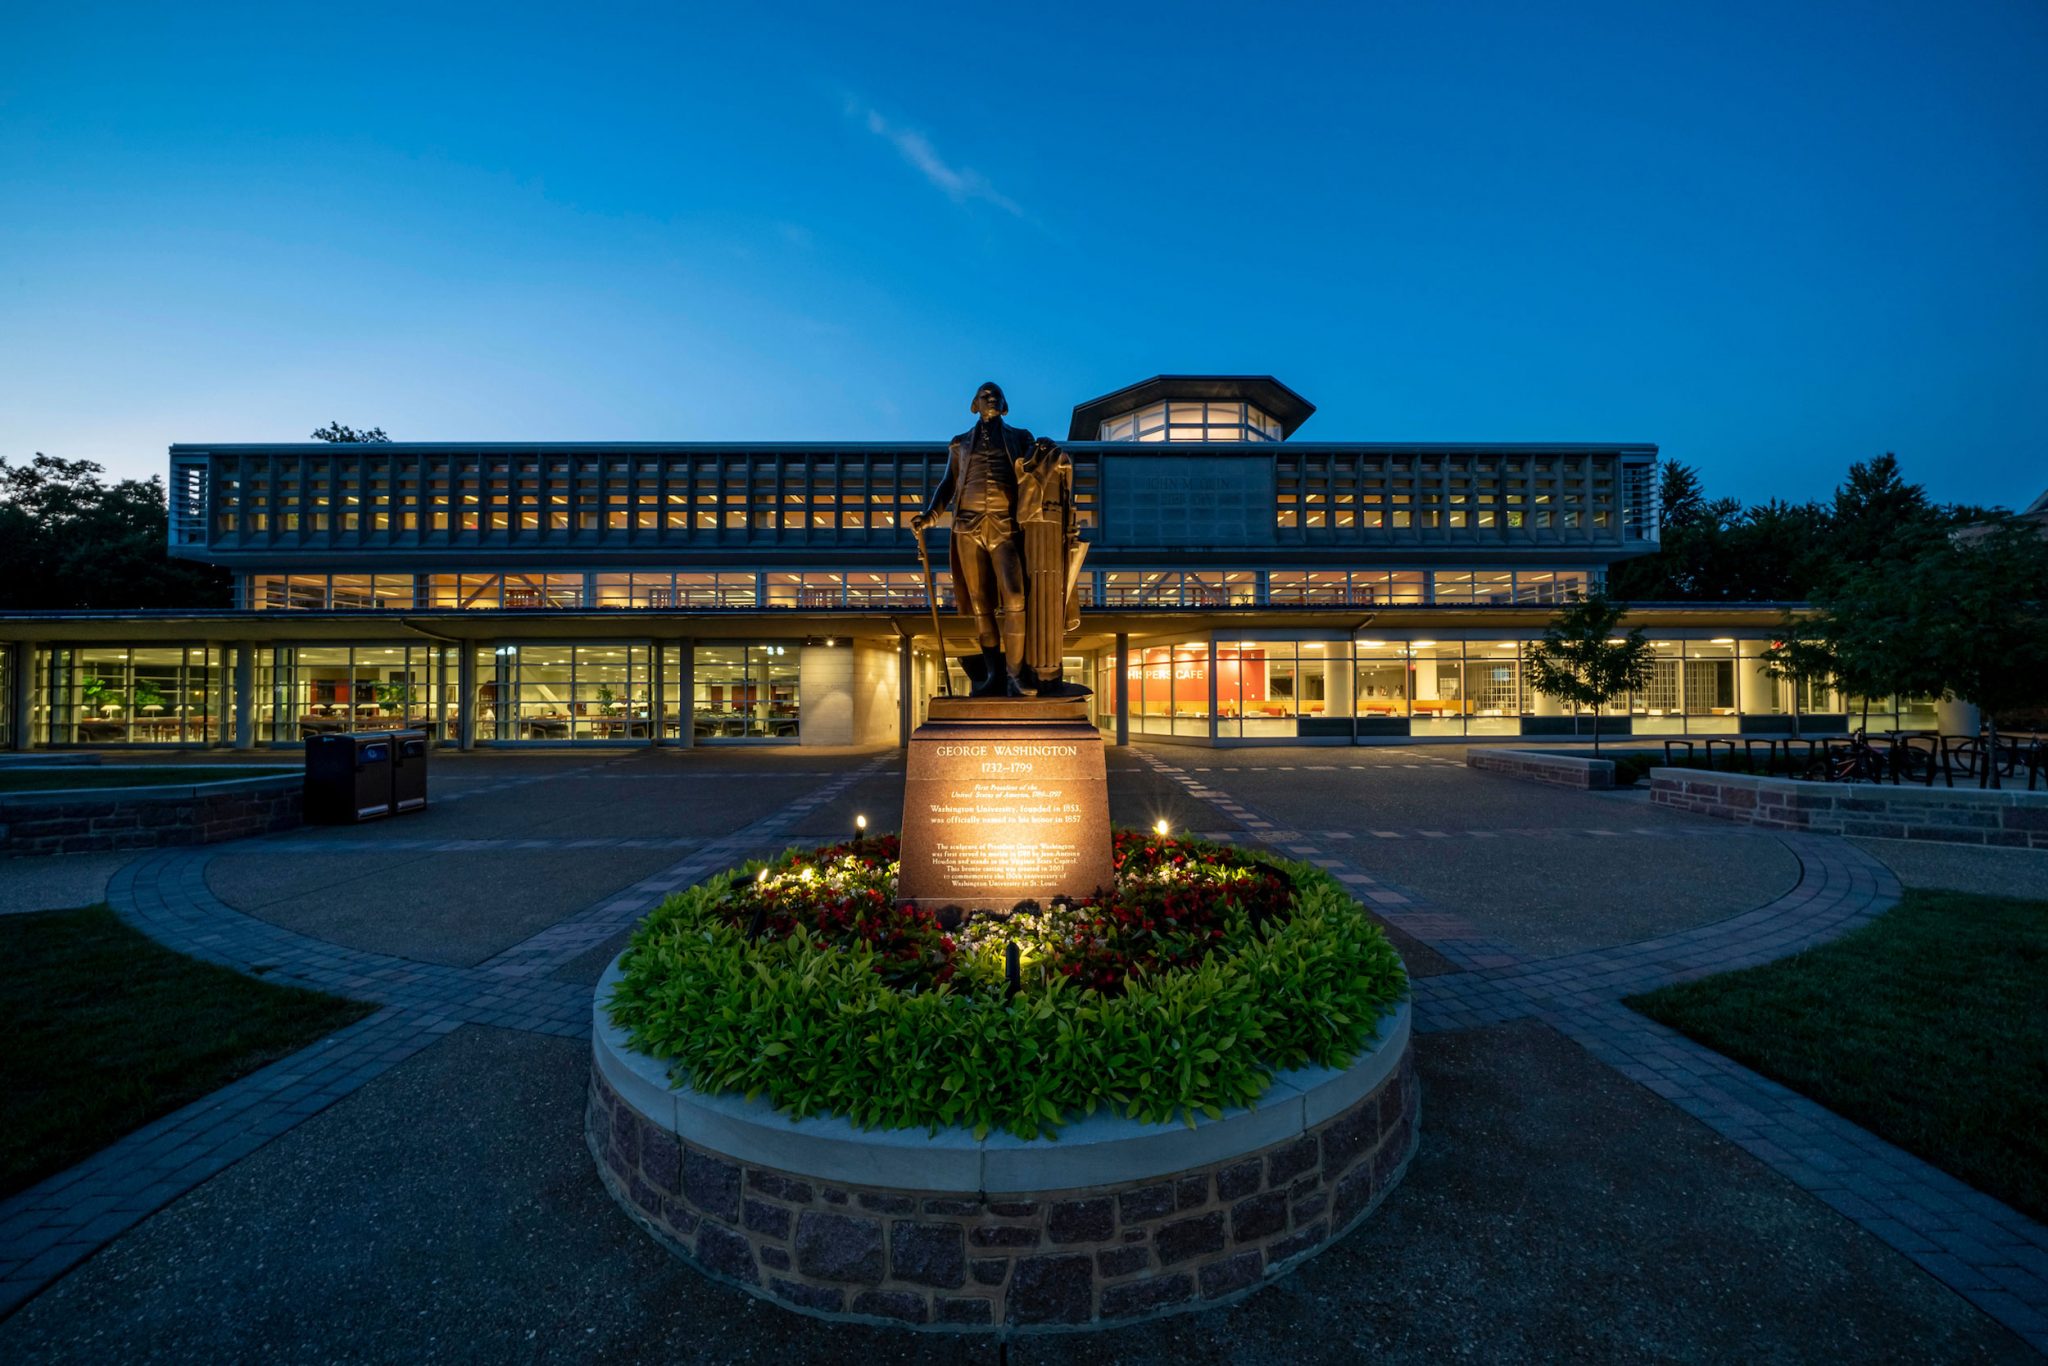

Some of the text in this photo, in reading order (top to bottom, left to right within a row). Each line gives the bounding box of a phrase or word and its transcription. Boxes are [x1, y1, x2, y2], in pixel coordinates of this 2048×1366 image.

[1128, 669, 1204, 680] HISPERS CAFE
[936, 745, 1077, 757] GEORGE WASHINGTON
[930, 804, 974, 814] Washington
[1020, 804, 1051, 813] founded
[1053, 804, 1061, 813] in
[946, 815, 980, 824] officially
[1031, 815, 1053, 823] honor
[1055, 815, 1063, 823] in
[950, 843, 977, 851] sculpture
[1040, 843, 1075, 851] Washington
